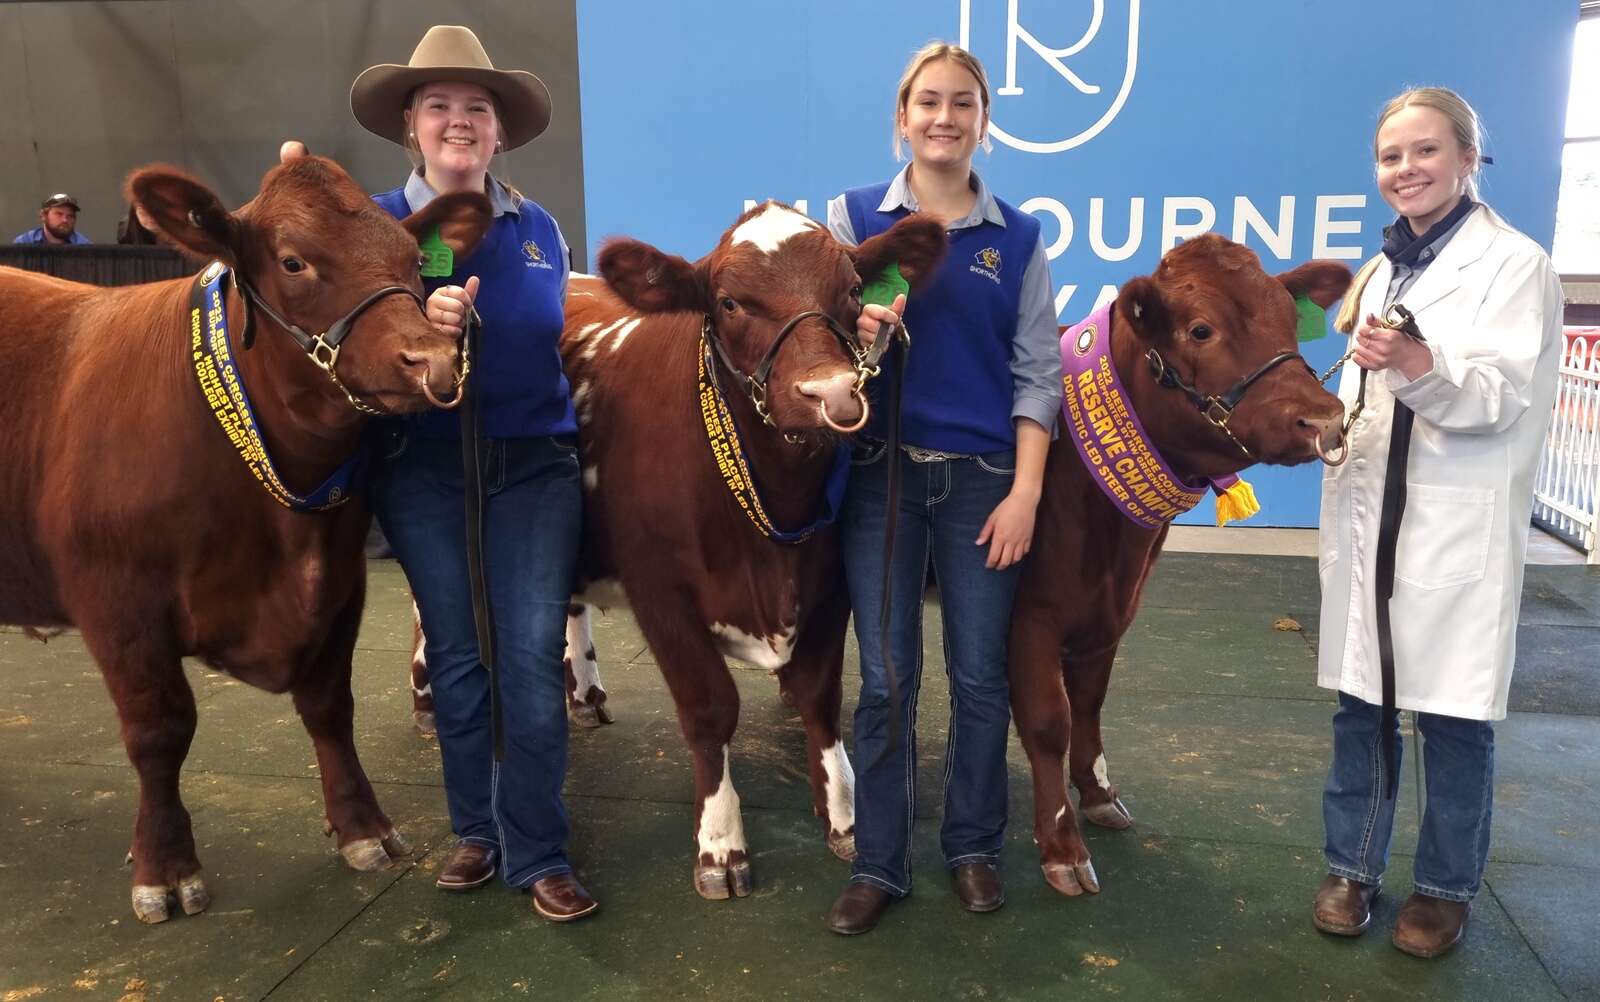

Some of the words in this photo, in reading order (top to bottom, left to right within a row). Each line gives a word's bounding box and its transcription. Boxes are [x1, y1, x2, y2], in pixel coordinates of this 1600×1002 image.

[212, 290, 223, 325] 2022
[191, 308, 202, 351] SCHOOL
[208, 309, 224, 369] SUPPORTED
[216, 327, 230, 361] BEEF
[193, 351, 203, 361] &
[195, 361, 222, 410] COLLEGE
[225, 364, 253, 427] CARCASE
[699, 382, 706, 391] &
[204, 354, 234, 411] HIGHEST
[228, 412, 259, 463] PLACED
[215, 409, 245, 449] EXHIBIT
[700, 392, 717, 439] COLLEGE
[1096, 372, 1123, 426] SUPPORTED
[1120, 426, 1131, 439] BY
[1127, 438, 1140, 455] HW
[1099, 354, 1114, 386] 2022
[1109, 388, 1130, 418] BEEF
[1125, 420, 1162, 474] CARCASE
[239, 449, 252, 462] IN
[706, 386, 726, 441] HIGHEST
[720, 442, 745, 491] PLACED
[710, 438, 732, 478] EXHIBIT
[1063, 374, 1089, 440] DOMESTIC
[1083, 440, 1103, 465] LED
[1098, 466, 1130, 502] STEER
[1126, 502, 1144, 517] OR
[1077, 368, 1128, 459] RESERVE
[1115, 457, 1185, 519] CHAMPI
[248, 462, 264, 481] LED
[726, 478, 738, 491] IN
[734, 491, 748, 509] LED
